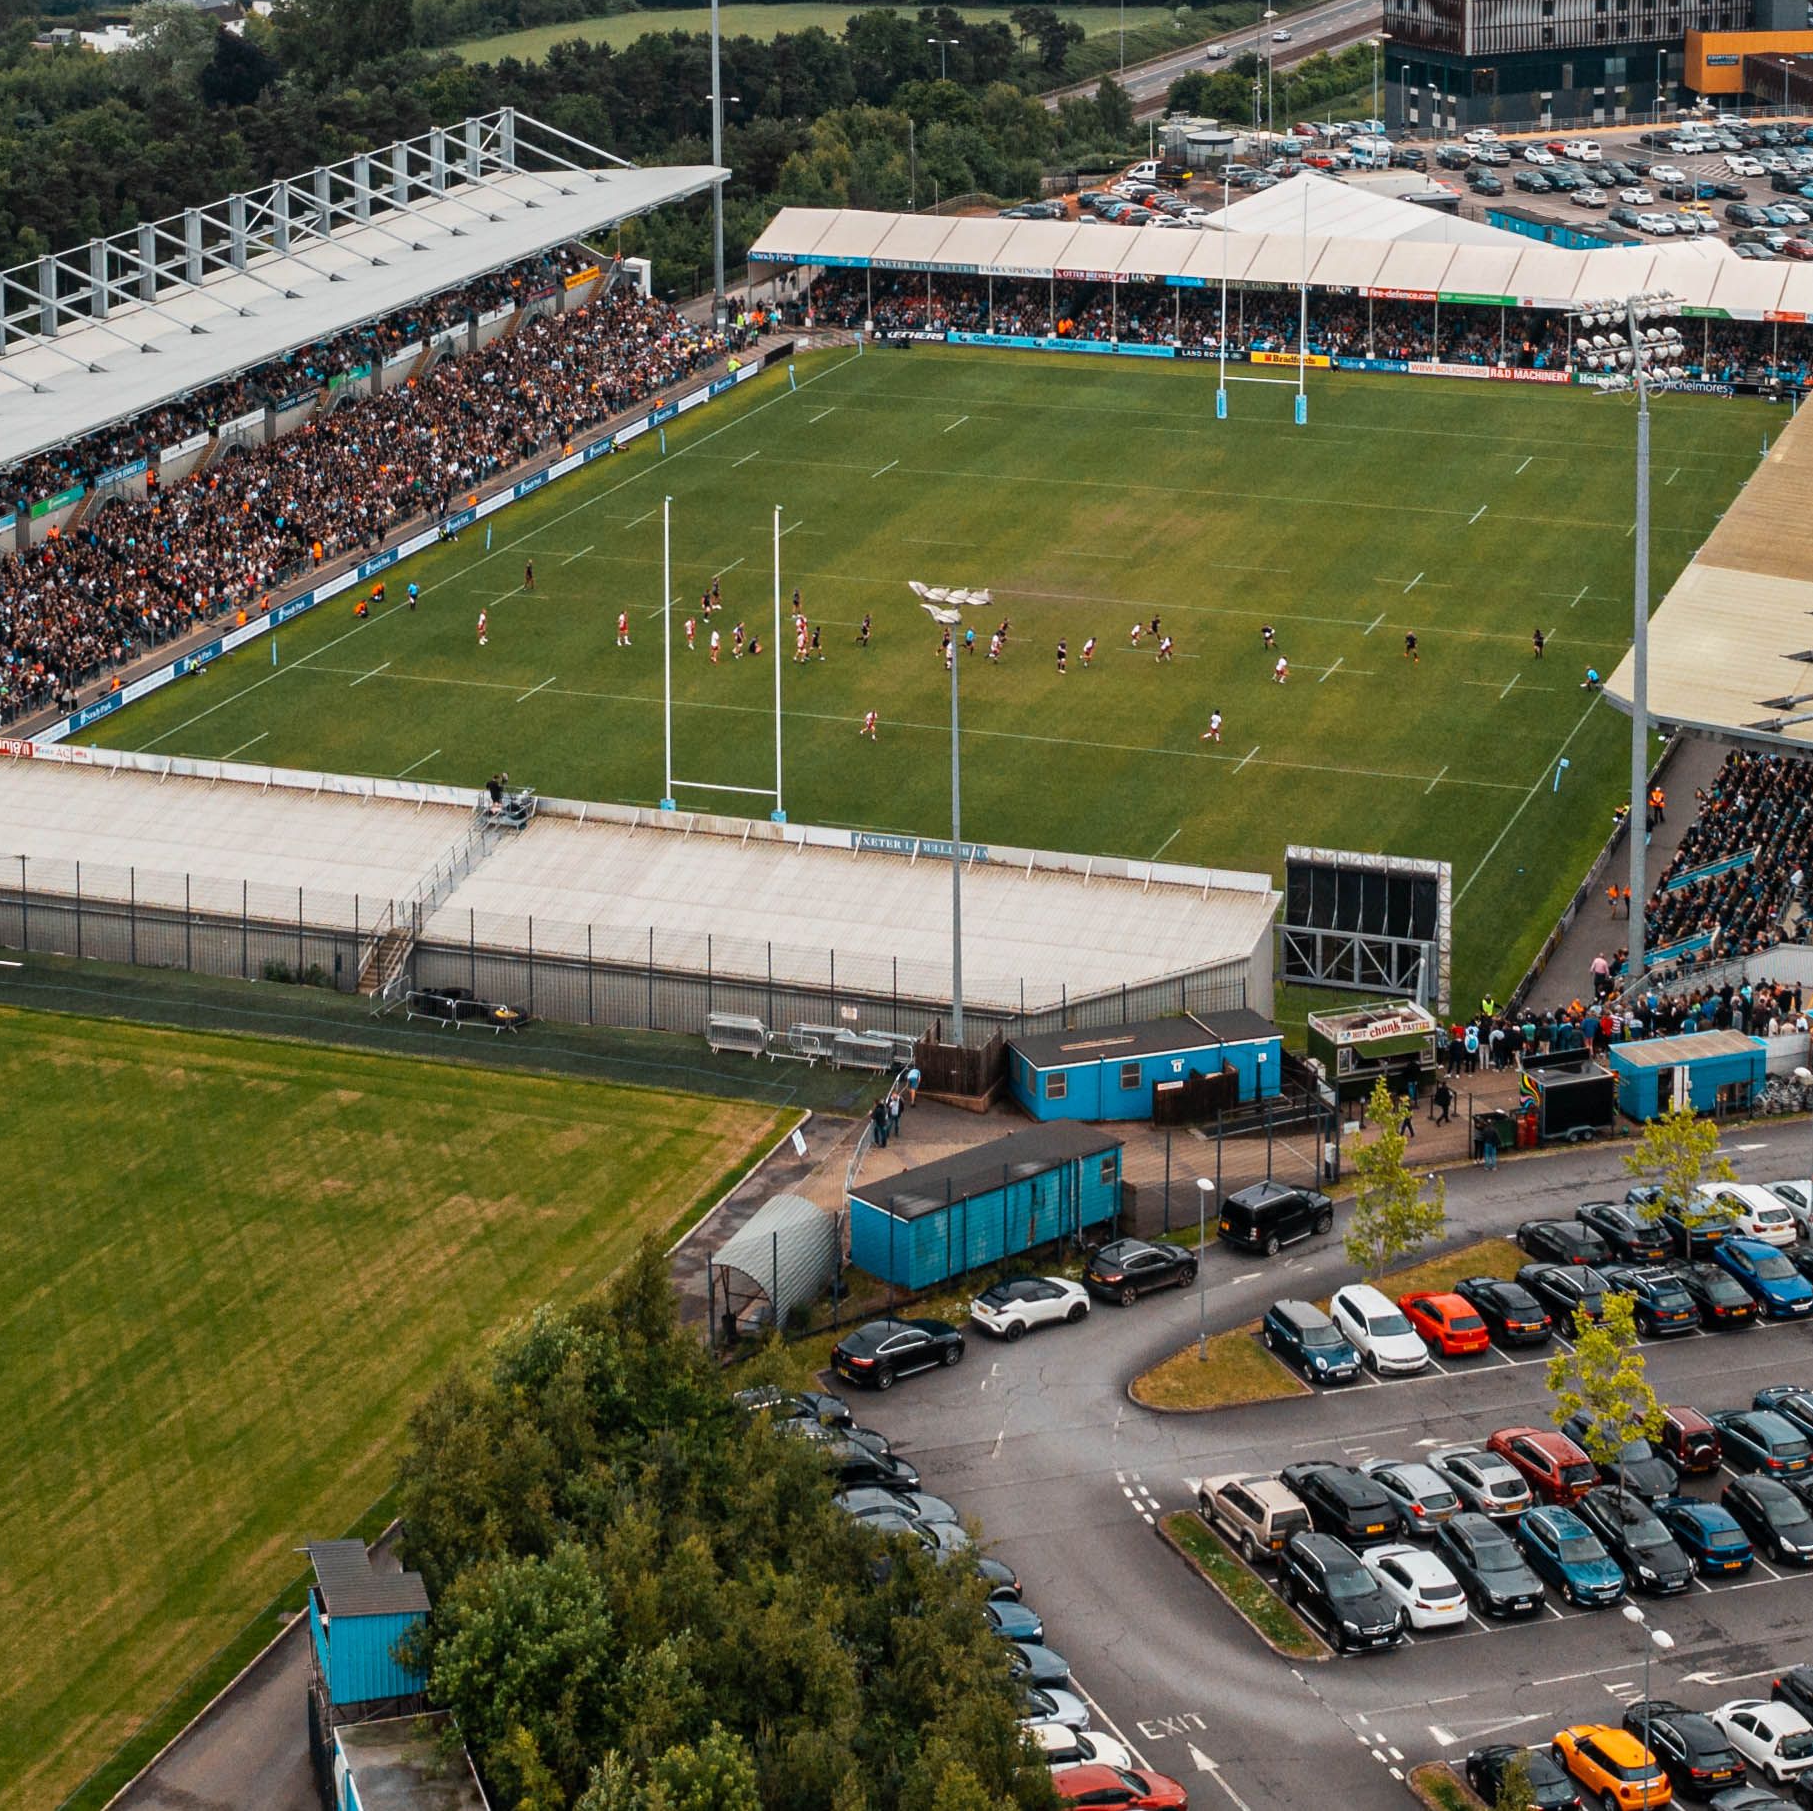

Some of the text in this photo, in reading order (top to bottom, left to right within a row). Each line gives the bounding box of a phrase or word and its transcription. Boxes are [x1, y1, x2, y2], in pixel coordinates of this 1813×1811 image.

[872, 260, 910, 269] EXETER
[912, 262, 935, 272] LIVE
[938, 264, 976, 274] BETTER
[1062, 270, 1119, 281] OTTER BREWERY
[1370, 288, 1436, 301] fire-defence.com
[1048, 338, 1088, 350] Gallagher
[1182, 350, 1201, 358] LAND
[1204, 351, 1229, 359] ROVR
[1272, 354, 1316, 365] Bradfrds
[1435, 366, 1487, 376] SOLICITORS
[1490, 368, 1570, 382] R&D MACHINERY
[1660, 380, 1728, 394] Michelmores
[1370, 1021, 1400, 1038] chunk
[1402, 1021, 1430, 1032] PASTIES
[1136, 1712, 1207, 1740] EXIT
